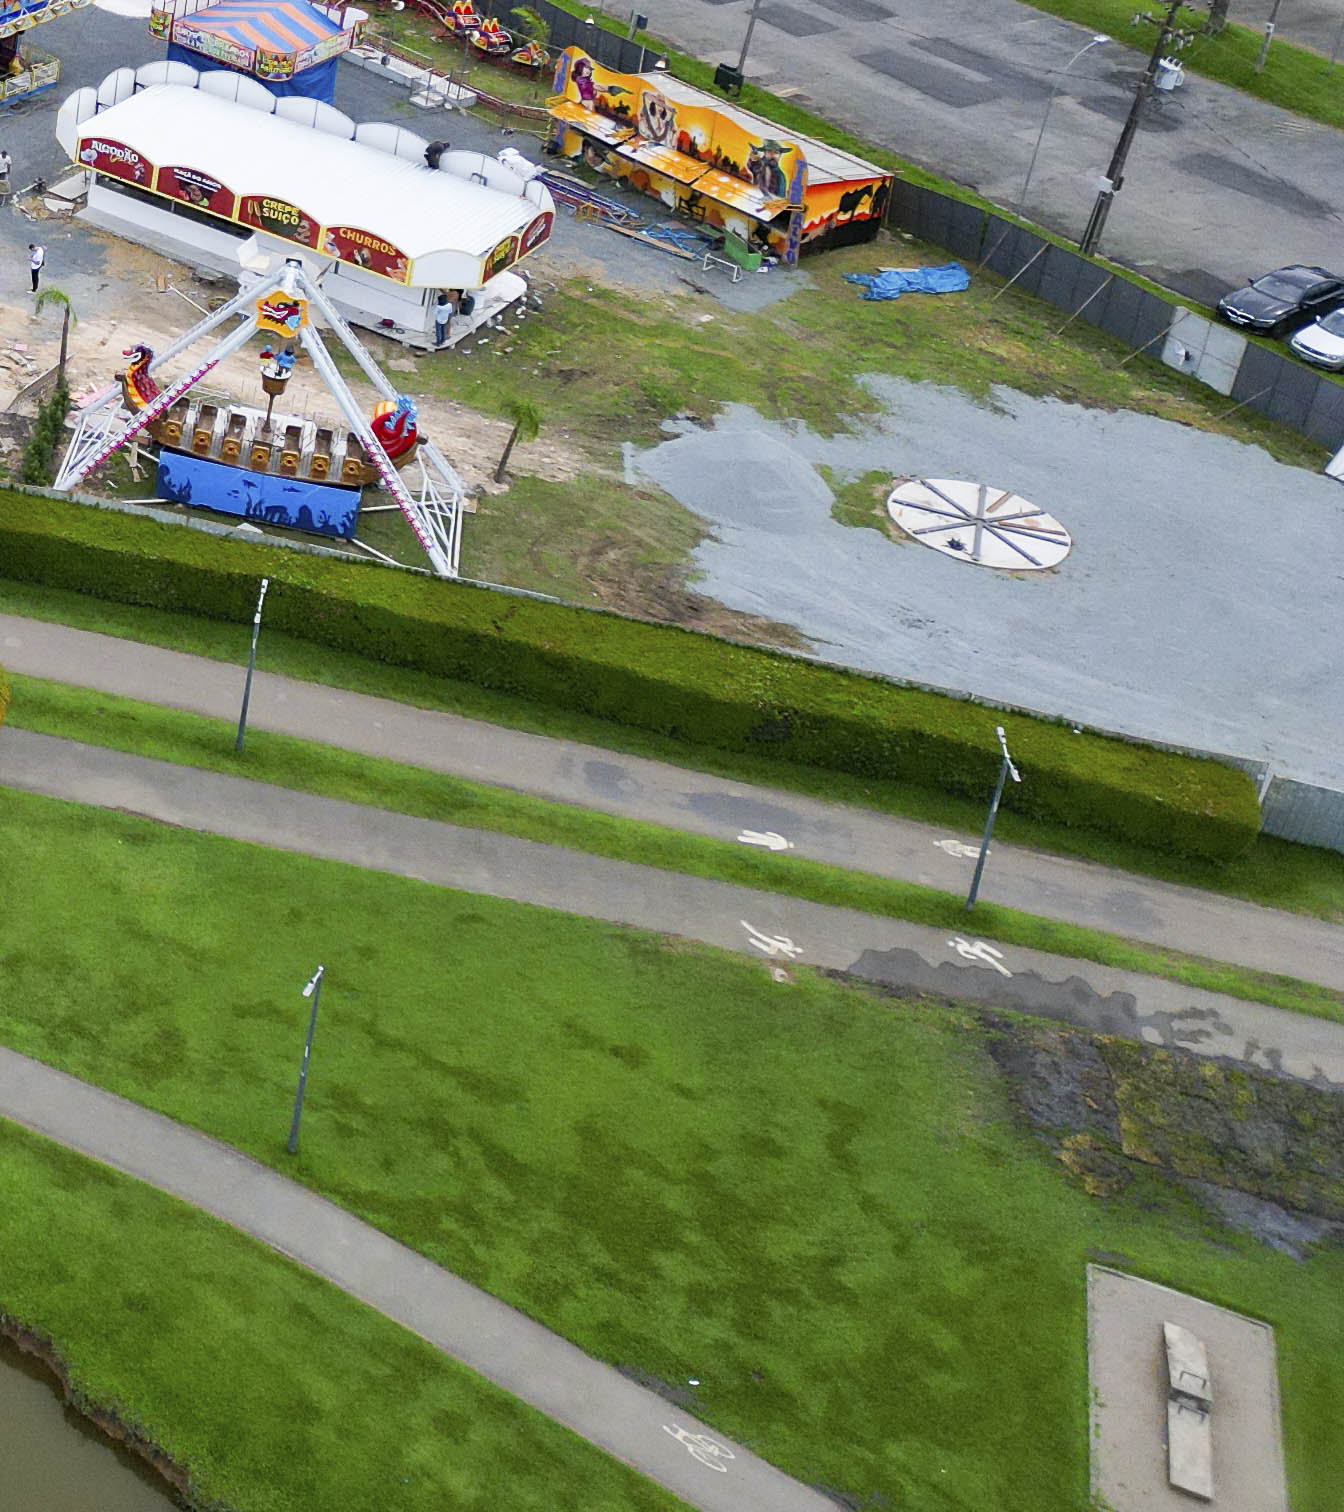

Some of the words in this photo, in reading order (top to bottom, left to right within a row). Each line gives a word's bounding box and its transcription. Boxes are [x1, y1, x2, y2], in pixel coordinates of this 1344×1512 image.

[91, 140, 139, 163] ALGODÃO
[262, 199, 300, 216] CREPE
[262, 207, 300, 225] SUIÇO
[339, 227, 397, 257] CHURROS
